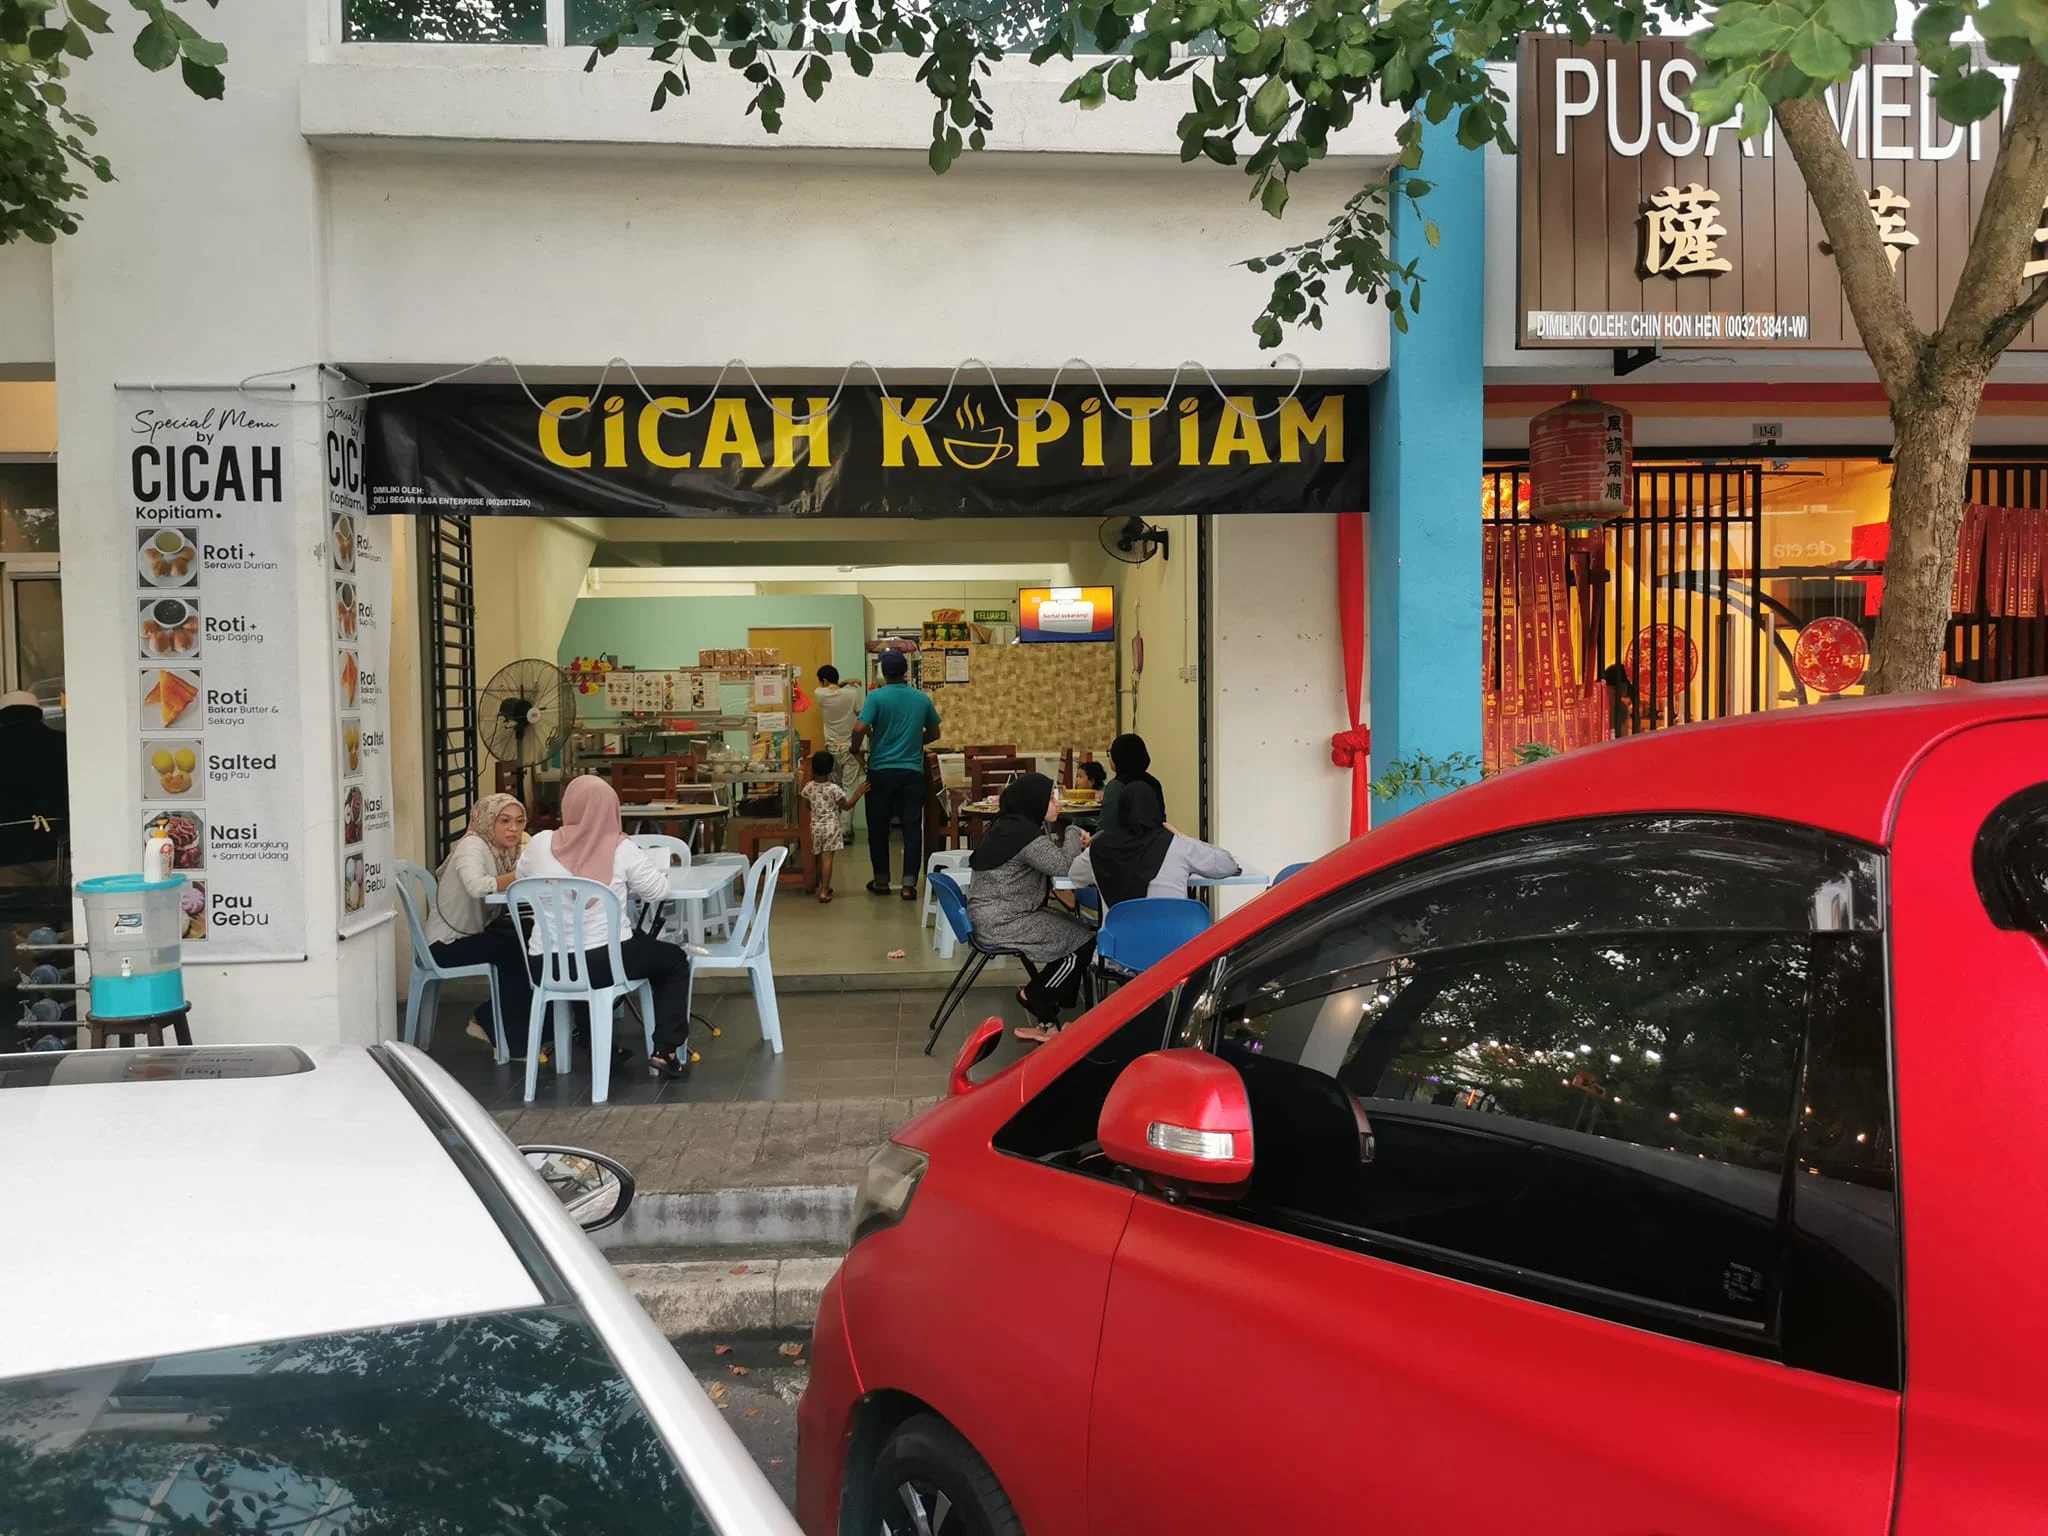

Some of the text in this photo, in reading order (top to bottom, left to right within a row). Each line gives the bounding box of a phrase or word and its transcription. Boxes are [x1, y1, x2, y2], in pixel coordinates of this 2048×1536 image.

[1556, 58, 1773, 158] PUSA
[1536, 315, 1808, 338] DIMILIKI OLEH: CHIN HON HEN (003213841-W)
[130, 407, 280, 445] Special Menu
[196, 431, 215, 446] by
[131, 445, 283, 503] CICAH
[401, 486, 425, 495] OLEH:
[373, 496, 389, 505] DELI
[389, 496, 416, 505] SEGAR
[416, 496, 438, 505] RASA
[438, 497, 485, 506] ENTERPRISE
[135, 505, 222, 524] Kopitiam.
[203, 544, 244, 560] Roti
[203, 560, 278, 570] Serawa Durian
[205, 616, 246, 632] Roti
[206, 632, 264, 644] Sup Daging
[207, 689, 248, 705] Roti
[207, 705, 280, 714] Bakar Butter &
[207, 716, 245, 726] Sekaya
[209, 754, 277, 770] Salted
[209, 771, 250, 781] Egg Pau
[210, 824, 258, 840] Nasi
[211, 840, 289, 851] Lemak Kangkung
[219, 851, 257, 860] Sambal
[259, 851, 289, 862] Udang
[364, 863, 381, 877] Pau
[365, 876, 387, 894] Gebu
[212, 893, 253, 909] Pau
[212, 910, 269, 926] Gebu
